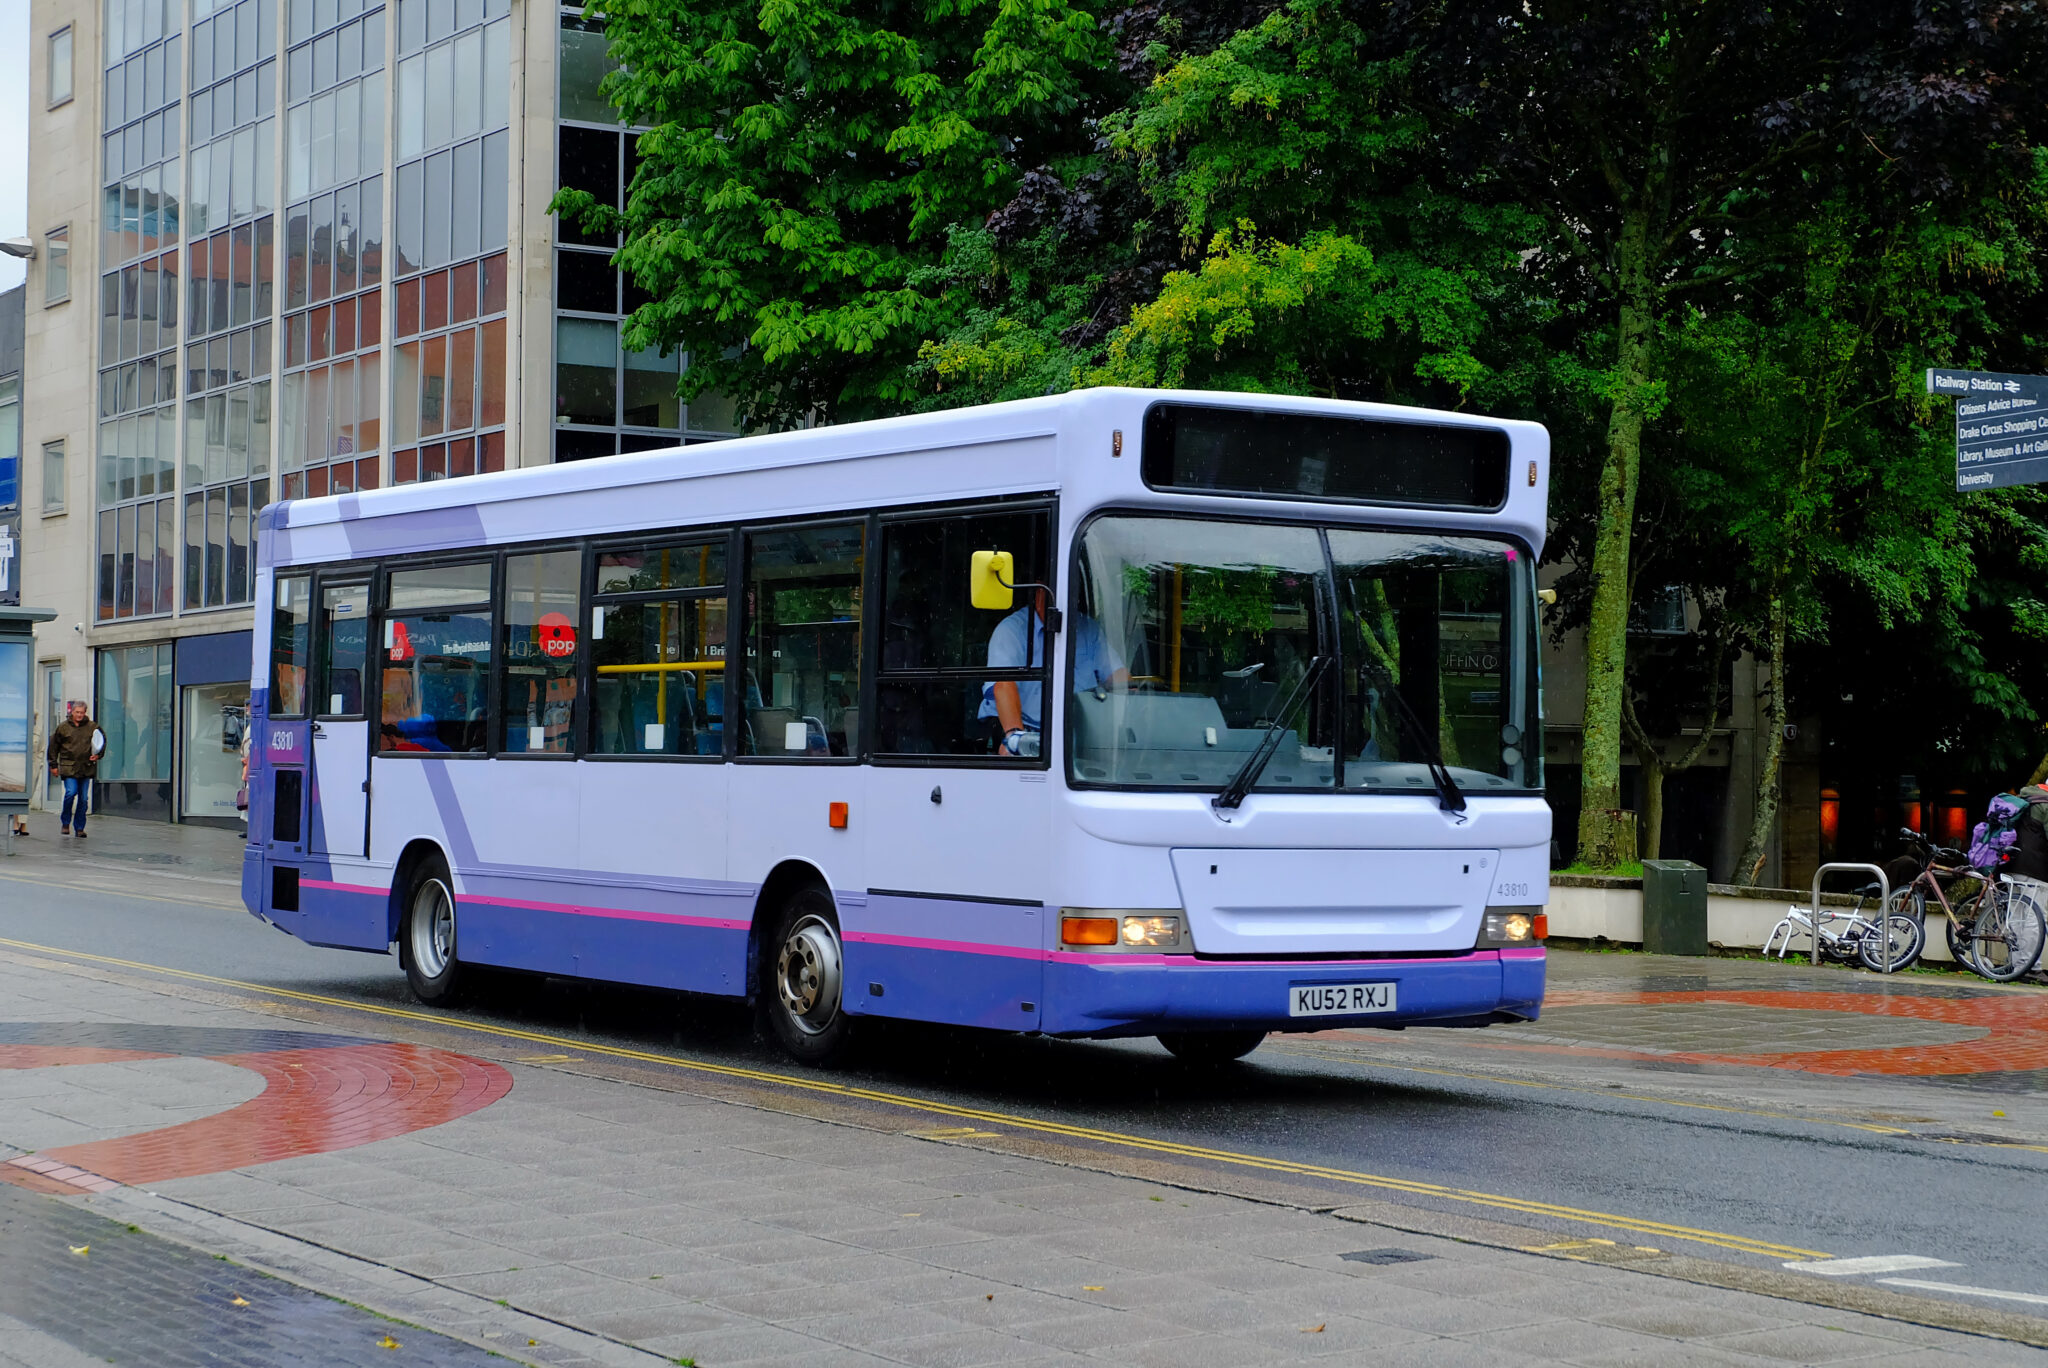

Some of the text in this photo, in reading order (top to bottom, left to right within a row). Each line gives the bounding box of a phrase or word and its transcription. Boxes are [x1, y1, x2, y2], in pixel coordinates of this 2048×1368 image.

[1935, 375, 2003, 391] Railway Station
[1960, 403, 1986, 416] Citizens
[1987, 399, 2011, 412] Advice
[1960, 427, 1980, 439] Drake
[1981, 425, 2003, 436] Circus
[2004, 418, 2037, 433] Shopping
[1985, 447, 2014, 459] Museum
[2015, 444, 2021, 455] &
[2022, 442, 2034, 454] Art
[1960, 471, 1994, 486] University
[547, 639, 576, 653] pop
[271, 730, 294, 751] 43810
[1497, 883, 1528, 897] 43810
[1299, 986, 1388, 1012] KU52 RXJ
